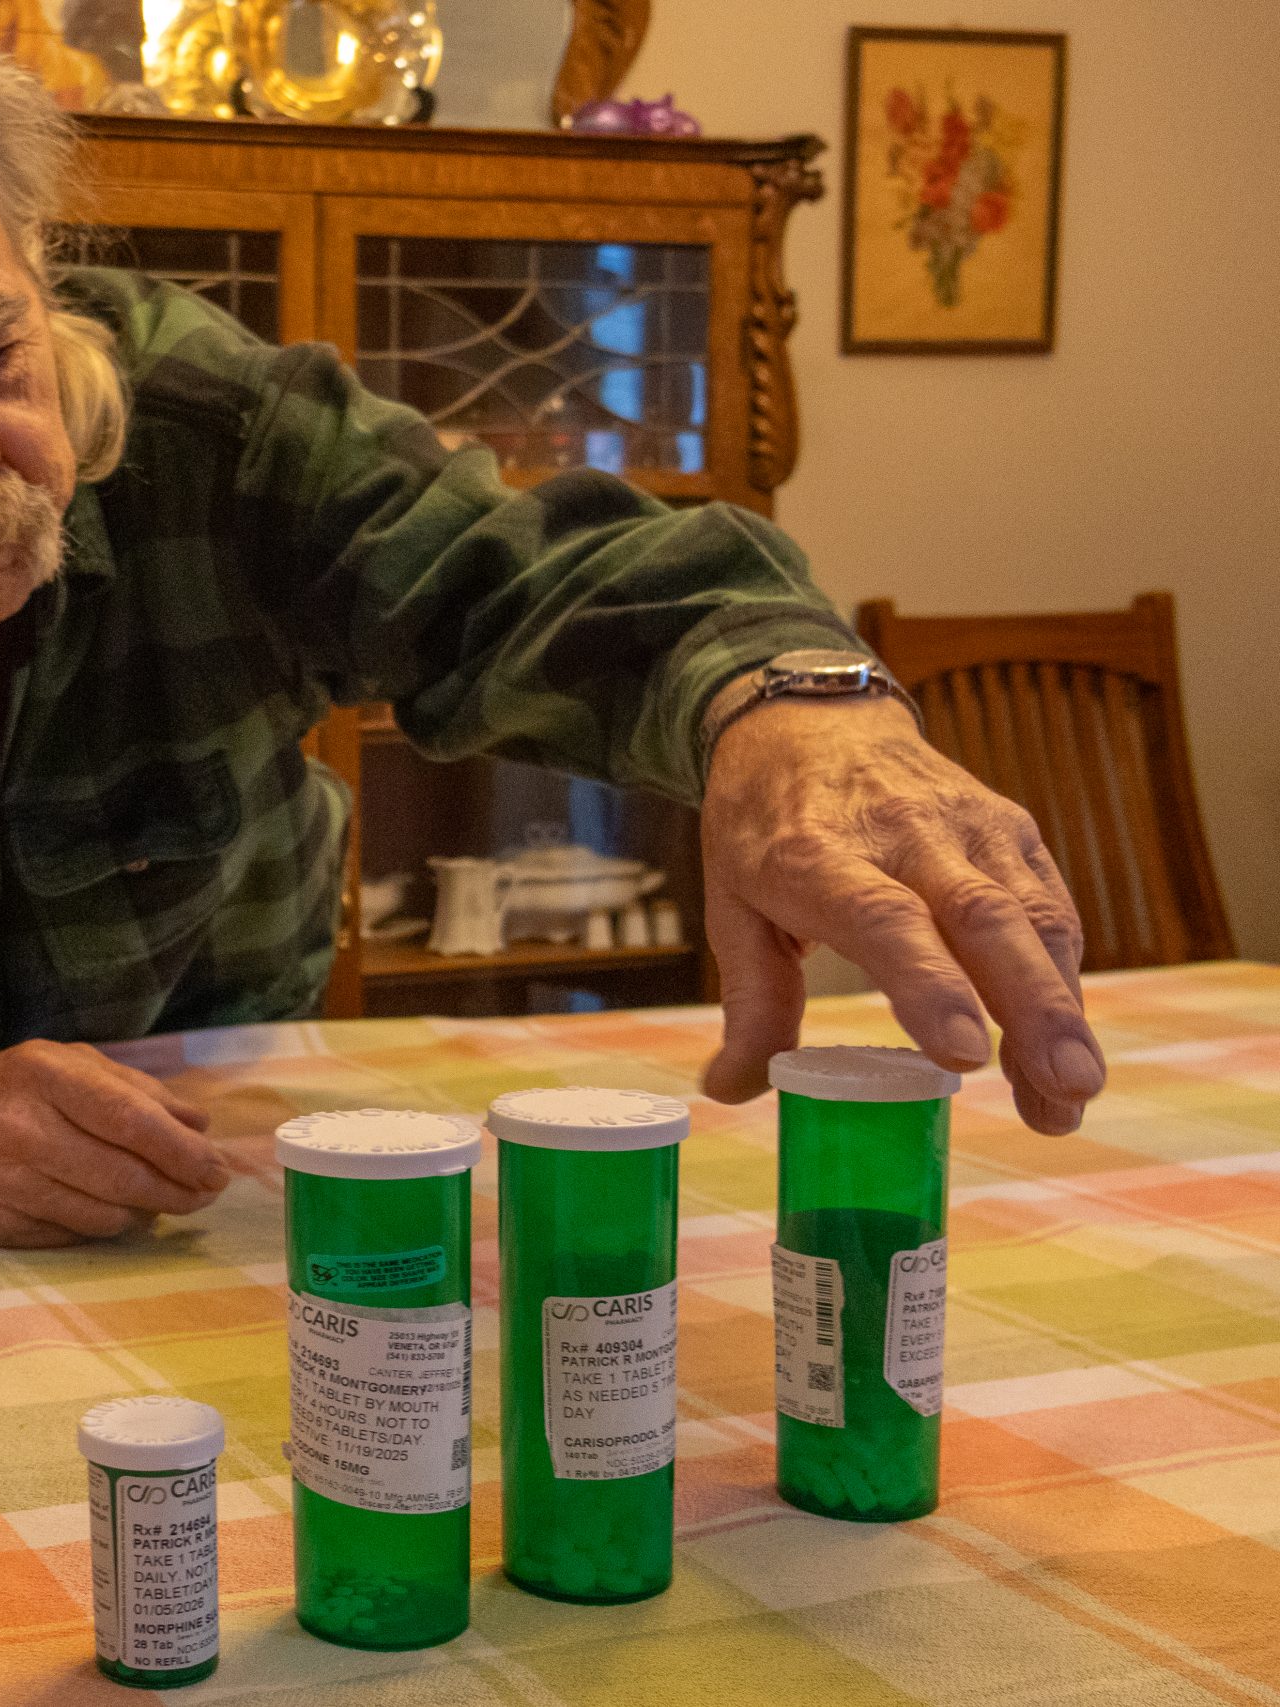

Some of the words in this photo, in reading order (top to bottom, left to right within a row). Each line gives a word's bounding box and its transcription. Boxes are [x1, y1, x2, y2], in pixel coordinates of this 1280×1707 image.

[593, 1294, 653, 1317] CARIS
[302, 1306, 360, 1338] CARIS
[561, 1341, 590, 1354] Rx#
[595, 1339, 644, 1355] 409304
[561, 1355, 620, 1368] PATRICK
[623, 1354, 632, 1365] R
[563, 1372, 603, 1385] TAKE
[622, 1360, 666, 1383] TABLET
[329, 1372, 426, 1397] MONTGOMERY
[563, 1390, 583, 1401] AS
[589, 1384, 649, 1402] NEEDED
[313, 1381, 361, 1405] TABLET
[365, 1398, 385, 1412] BY
[388, 1400, 439, 1414] MOUTH
[563, 1406, 595, 1419] DAY
[375, 1416, 407, 1430] NOT
[410, 1418, 431, 1431] TO
[563, 1428, 660, 1448] CARISOPRODOL
[336, 1440, 410, 1462] 11/19/2025
[334, 1458, 371, 1477] 15MG
[133, 1523, 162, 1536] Rx#
[133, 1536, 192, 1549] PATRICK
[195, 1532, 203, 1544] R
[134, 1554, 173, 1567] TAKE
[133, 1597, 204, 1616] 01/05/2026
[134, 1616, 203, 1635] MORPHINE
[152, 1640, 174, 1650] Tab
[134, 1656, 151, 1667] NO
[155, 1655, 191, 1668] REFILL
